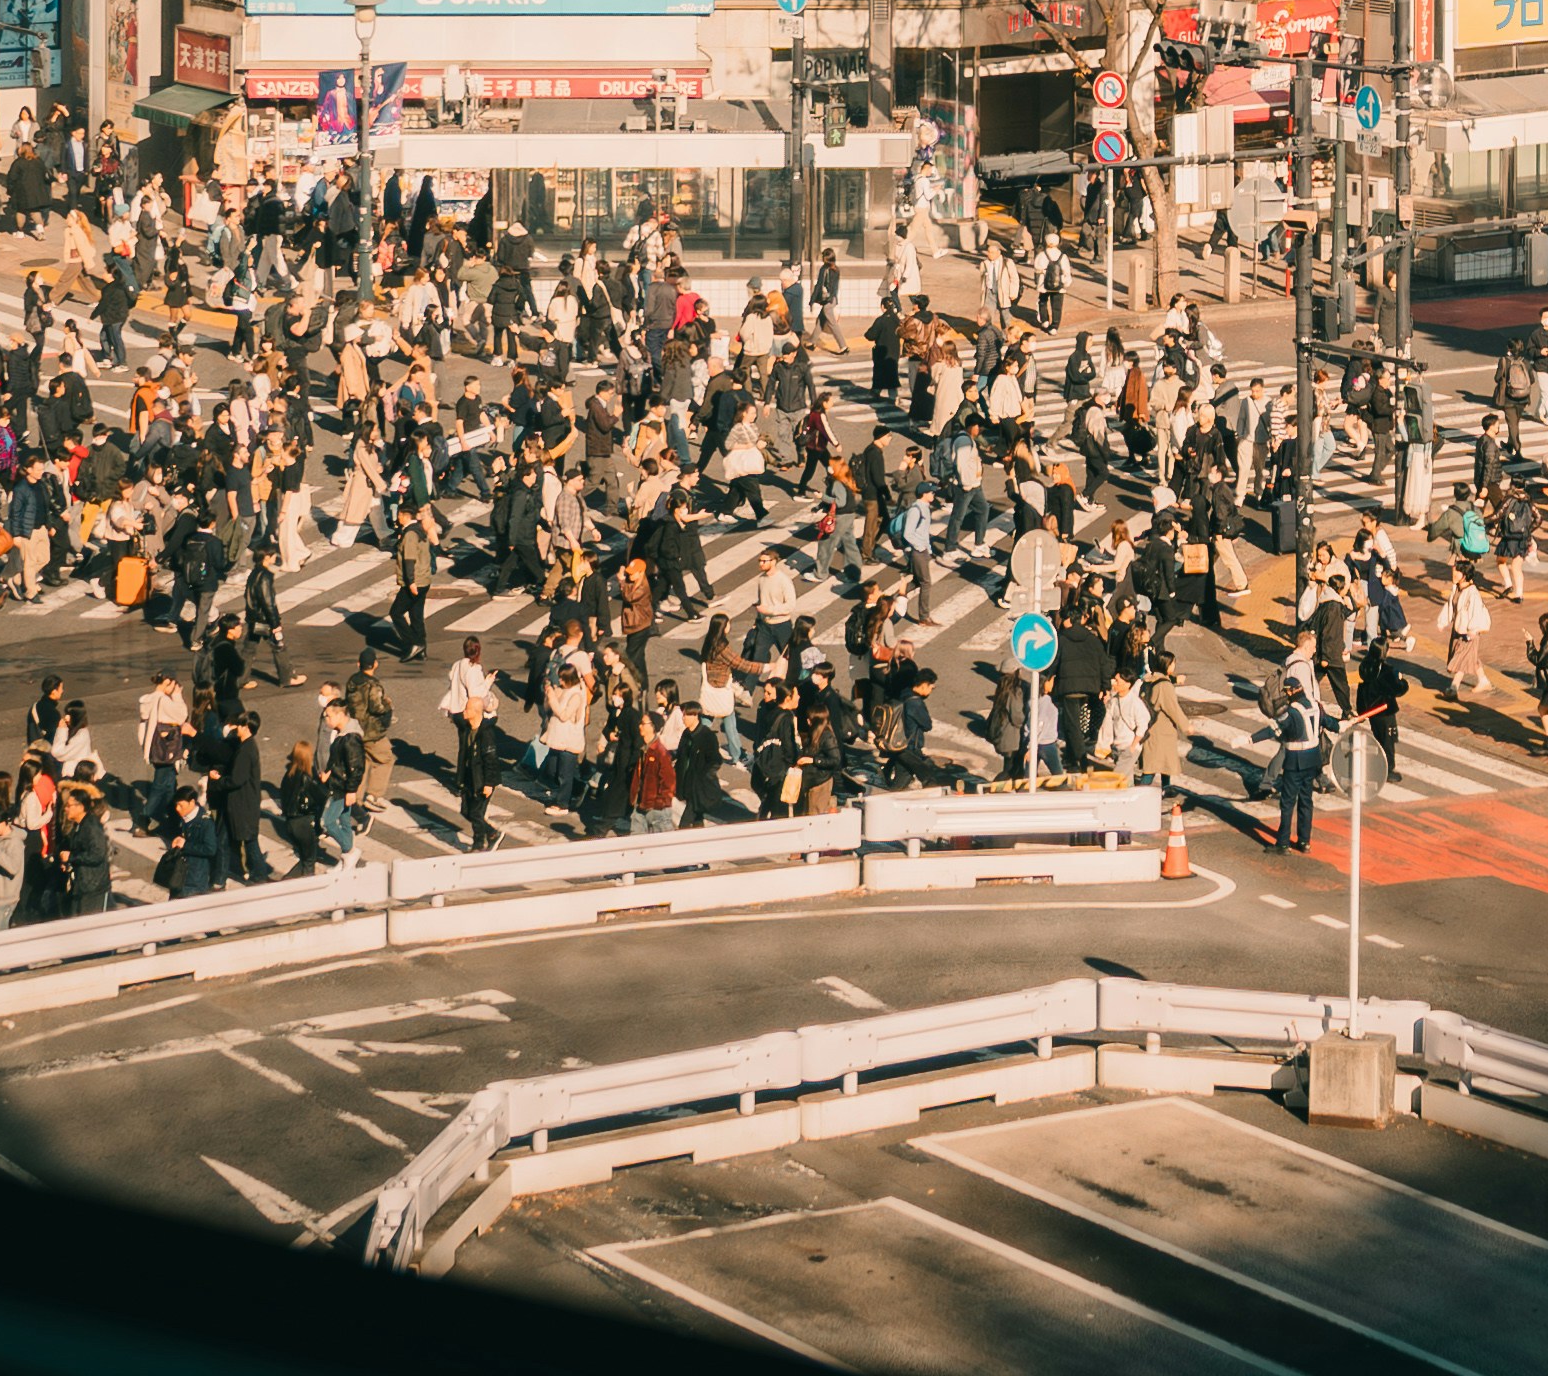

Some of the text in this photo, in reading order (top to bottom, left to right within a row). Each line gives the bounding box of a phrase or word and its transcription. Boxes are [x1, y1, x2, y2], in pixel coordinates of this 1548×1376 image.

[179, 43, 230, 76] 天津甘栗
[805, 56, 834, 79] POP
